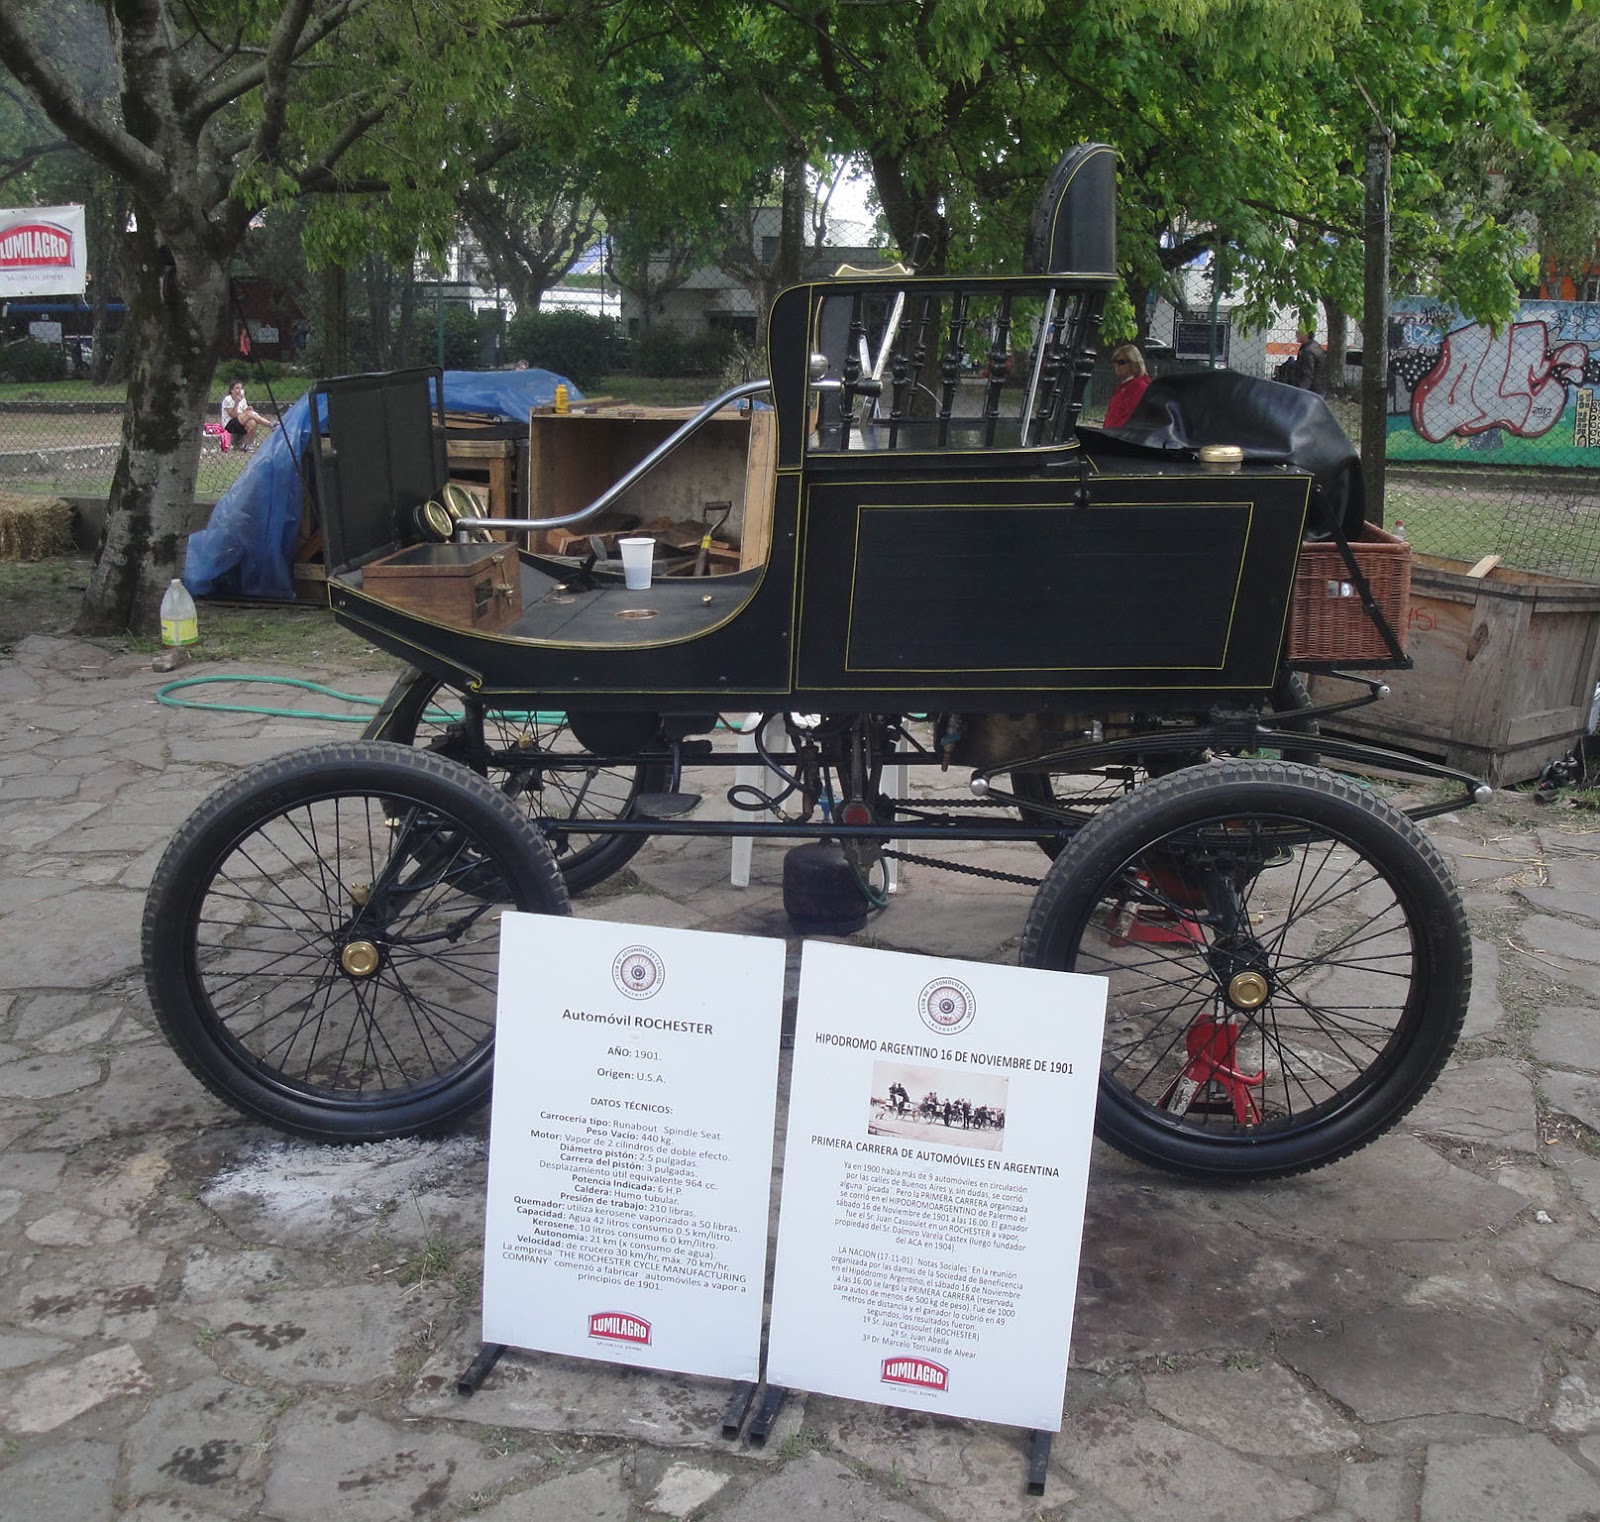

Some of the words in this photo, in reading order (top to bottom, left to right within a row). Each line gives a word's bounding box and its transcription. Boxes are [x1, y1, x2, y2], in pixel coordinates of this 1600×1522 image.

[0, 231, 67, 259] LUMILAGRO
[562, 1008, 630, 1026] Automóvil
[634, 1016, 712, 1035] ROCHESTER
[607, 1045, 631, 1057] AÑO:
[635, 1049, 661, 1060] 1901.
[815, 1032, 877, 1050] HIPODROMO
[879, 1041, 938, 1058] ARGENTINO
[940, 1048, 952, 1060] 16
[954, 1050, 968, 1062] DE
[970, 1052, 1031, 1070] NOVIEMBRE
[1033, 1059, 1047, 1071] DE
[1049, 1061, 1073, 1074] 1901
[596, 1067, 634, 1079] Origen:
[636, 1072, 665, 1083] U.S.A.
[590, 1097, 620, 1108] DATOS
[624, 1100, 673, 1114] TÉCNICOS:
[540, 1110, 586, 1124] Carrocería
[589, 1117, 610, 1126] tipo:
[612, 1119, 656, 1132] Runabout
[663, 1126, 697, 1137] Spindle
[586, 1126, 607, 1136] Peso
[641, 1133, 658, 1142] 440
[530, 1129, 562, 1140] Motor:
[564, 1133, 590, 1144] Vapor
[593, 1137, 605, 1146] de
[615, 1140, 653, 1152] cilindros
[656, 1145, 667, 1153] de
[670, 1146, 696, 1157] doble
[559, 1142, 602, 1155] Diámetro
[604, 1149, 637, 1160] pistón:
[639, 1152, 653, 1161] 2.5
[559, 1152, 593, 1164] Carrera
[595, 1157, 610, 1166] del
[612, 1159, 644, 1170] pistón:
[647, 1163, 652, 1171] 3
[811, 1135, 852, 1150] PRIMERA
[855, 1141, 898, 1156] CARRERA
[900, 1147, 913, 1158] DE
[916, 1150, 985, 1168] AUTOMÓVILES
[987, 1159, 1000, 1170] EN
[1002, 1161, 1059, 1177] ARGENTINA
[539, 1160, 610, 1176] Desplazamiento
[629, 1173, 682, 1185] equivalente
[685, 1178, 702, 1187] 964
[571, 1174, 611, 1186] Potencia
[613, 1179, 655, 1192] Indicada:
[657, 1184, 663, 1193] 6
[863, 1163, 880, 1173] 1900
[934, 1175, 977, 1186] automóviles
[559, 1192, 593, 1203] Presión
[595, 1196, 607, 1205] de
[610, 1199, 647, 1211] trabajo:
[649, 1203, 666, 1213] 210
[574, 1184, 611, 1196] Caldera:
[613, 1189, 641, 1200] Humo
[920, 1191, 953, 1202] PRIMERA
[954, 1196, 988, 1207] CARRERA
[513, 1195, 564, 1209] Quemador:
[566, 1203, 593, 1213] utiliza
[594, 1206, 636, 1219] kerosene
[638, 1213, 689, 1226] vaporizado
[699, 1220, 710, 1228] 50
[862, 1202, 870, 1210] 16
[872, 1203, 881, 1212] de
[882, 1205, 920, 1217] Noviembre
[932, 1212, 948, 1222] 1901
[881, 1195, 888, 1203] el
[977, 1209, 987, 1217] de
[988, 1210, 1018, 1221] Palermo
[516, 1205, 565, 1219] Capacidad:
[568, 1212, 590, 1222] Agua
[593, 1216, 604, 1224] 42
[606, 1217, 629, 1227] litros
[631, 1222, 673, 1233] consumo
[675, 1227, 690, 1235] 0.5
[948, 1224, 990, 1237] ROCHESTER
[533, 1227, 587, 1241] Autonomía:
[590, 1234, 599, 1243] 21
[602, 1236, 616, 1245] km
[629, 1242, 671, 1252] consumo
[673, 1246, 685, 1254] de
[580, 1224, 590, 1232] 10
[592, 1225, 615, 1235] litros
[617, 1230, 659, 1241] consumo
[661, 1235, 676, 1243] 6.0
[895, 1236, 906, 1244] del
[907, 1237, 922, 1246] ACA
[516, 1234, 563, 1248] Velocidad:
[566, 1241, 577, 1249] de
[579, 1244, 613, 1254] crucero
[616, 1248, 627, 1256] 30
[686, 1257, 697, 1266] 70
[838, 1245, 846, 1254] LA
[848, 1247, 876, 1258] NACION
[502, 1242, 512, 1250] La
[514, 1245, 552, 1256] empresa
[578, 1252, 630, 1266] ROCHESTER
[633, 1260, 659, 1270] CYCLE
[662, 1264, 746, 1282] MANUFACTURING
[553, 1260, 594, 1271] comenzó
[604, 1265, 638, 1277] fabricar
[645, 1273, 700, 1286] automóviles
[711, 1282, 737, 1291] vapor
[577, 1272, 621, 1284] principios
[623, 1278, 635, 1286] de
[638, 1280, 662, 1290] 1901.
[908, 1285, 940, 1296] PRIMERA
[942, 1290, 975, 1301] CARRERA
[915, 1295, 928, 1304] 500
[929, 1297, 938, 1307] kg
[997, 1308, 1015, 1317] 1000
[593, 1316, 647, 1339] LUMILAGRO
[881, 1318, 897, 1327] Juan
[933, 1326, 979, 1342] (ROCHESTER)
[881, 1337, 910, 1348] Marcelo
[912, 1341, 941, 1353] Torcuato
[953, 1348, 976, 1358] Alvear
[909, 1332, 925, 1341] Juan
[927, 1335, 949, 1345] Abella
[886, 1361, 944, 1385] LUMILAGRO
